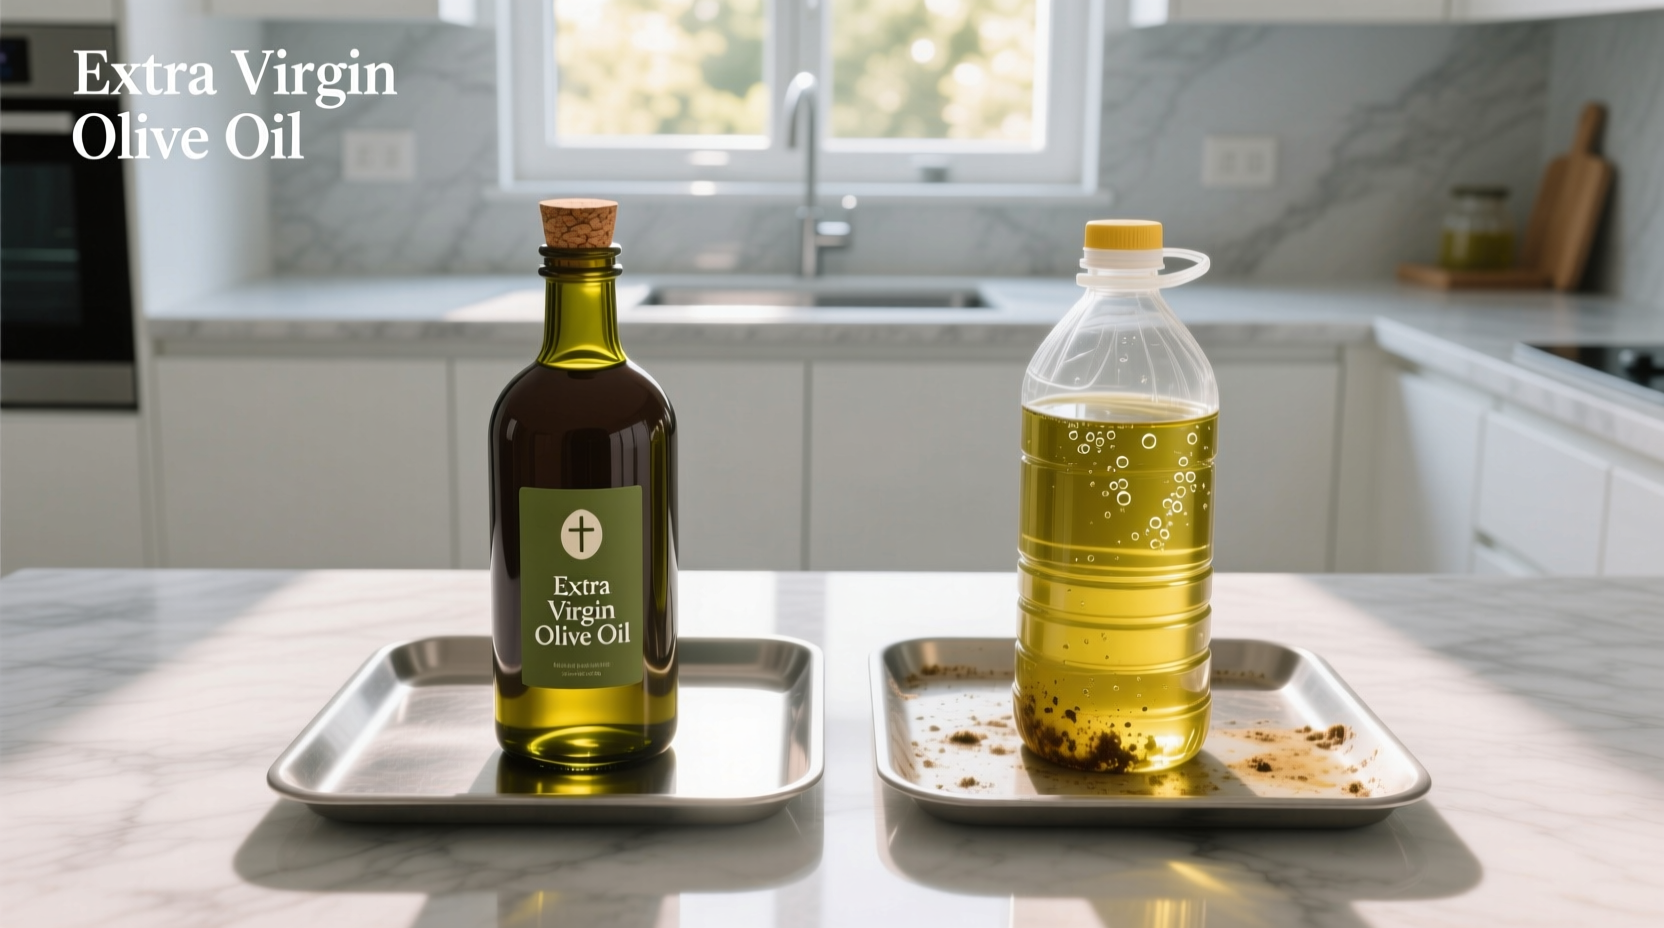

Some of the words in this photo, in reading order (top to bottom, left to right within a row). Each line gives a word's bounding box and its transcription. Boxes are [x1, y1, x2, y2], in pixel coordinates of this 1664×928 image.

[553, 575, 610, 597] Extra
[547, 599, 615, 626] Virgin
[535, 624, 591, 646] Olive
[597, 621, 630, 645] Oil
